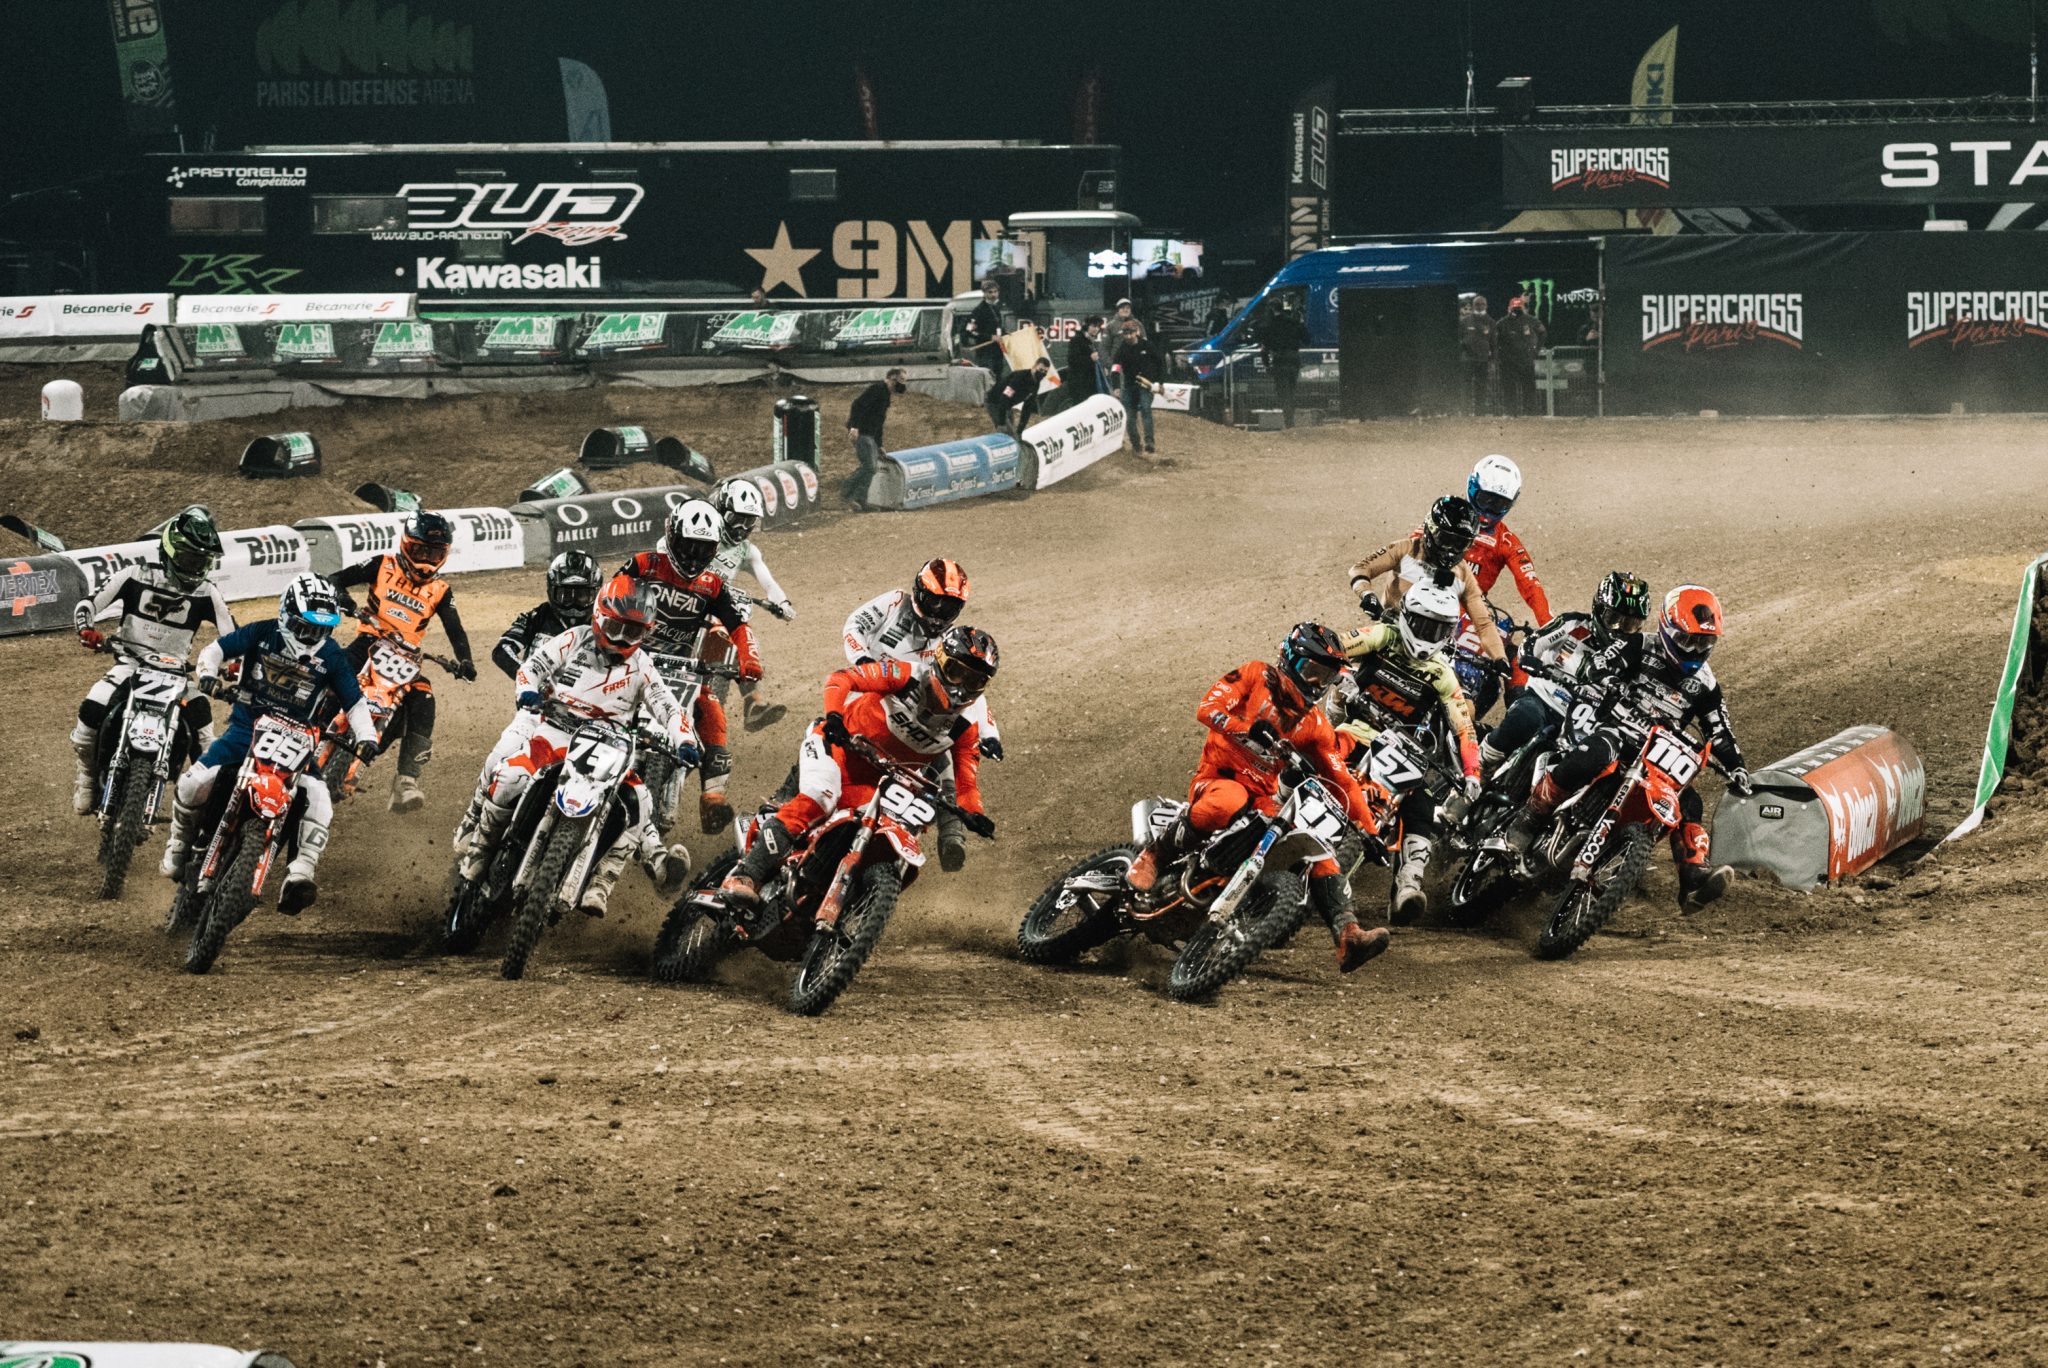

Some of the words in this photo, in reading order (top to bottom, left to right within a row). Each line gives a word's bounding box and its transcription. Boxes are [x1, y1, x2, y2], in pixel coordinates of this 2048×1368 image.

[1291, 112, 1304, 184] Kawasaki
[1551, 147, 1670, 184] SUPERCROSS
[188, 167, 307, 178] PASTORELLO
[236, 177, 306, 187] Compétition
[417, 256, 601, 289] Kawasaki
[63, 302, 133, 315] Bécanerie
[1642, 293, 1803, 342] SUPERCROSS
[1036, 436, 1063, 464] Bihr
[1066, 422, 1094, 451] Bihr
[1096, 407, 1124, 436] Bihr
[337, 521, 396, 552] Bihr
[459, 513, 514, 542] Bihr
[556, 526, 598, 543] OAKLEY
[611, 520, 651, 536] OAKLEY
[235, 534, 299, 567] Bihr
[371, 645, 420, 685] 589
[602, 676, 632, 695] FIRST
[891, 711, 940, 748] SHOT
[253, 731, 311, 772] 851
[1371, 745, 1424, 784] 57
[1646, 737, 1697, 785] 110
[879, 784, 936, 826] 92
[1761, 806, 1782, 816] AIR
